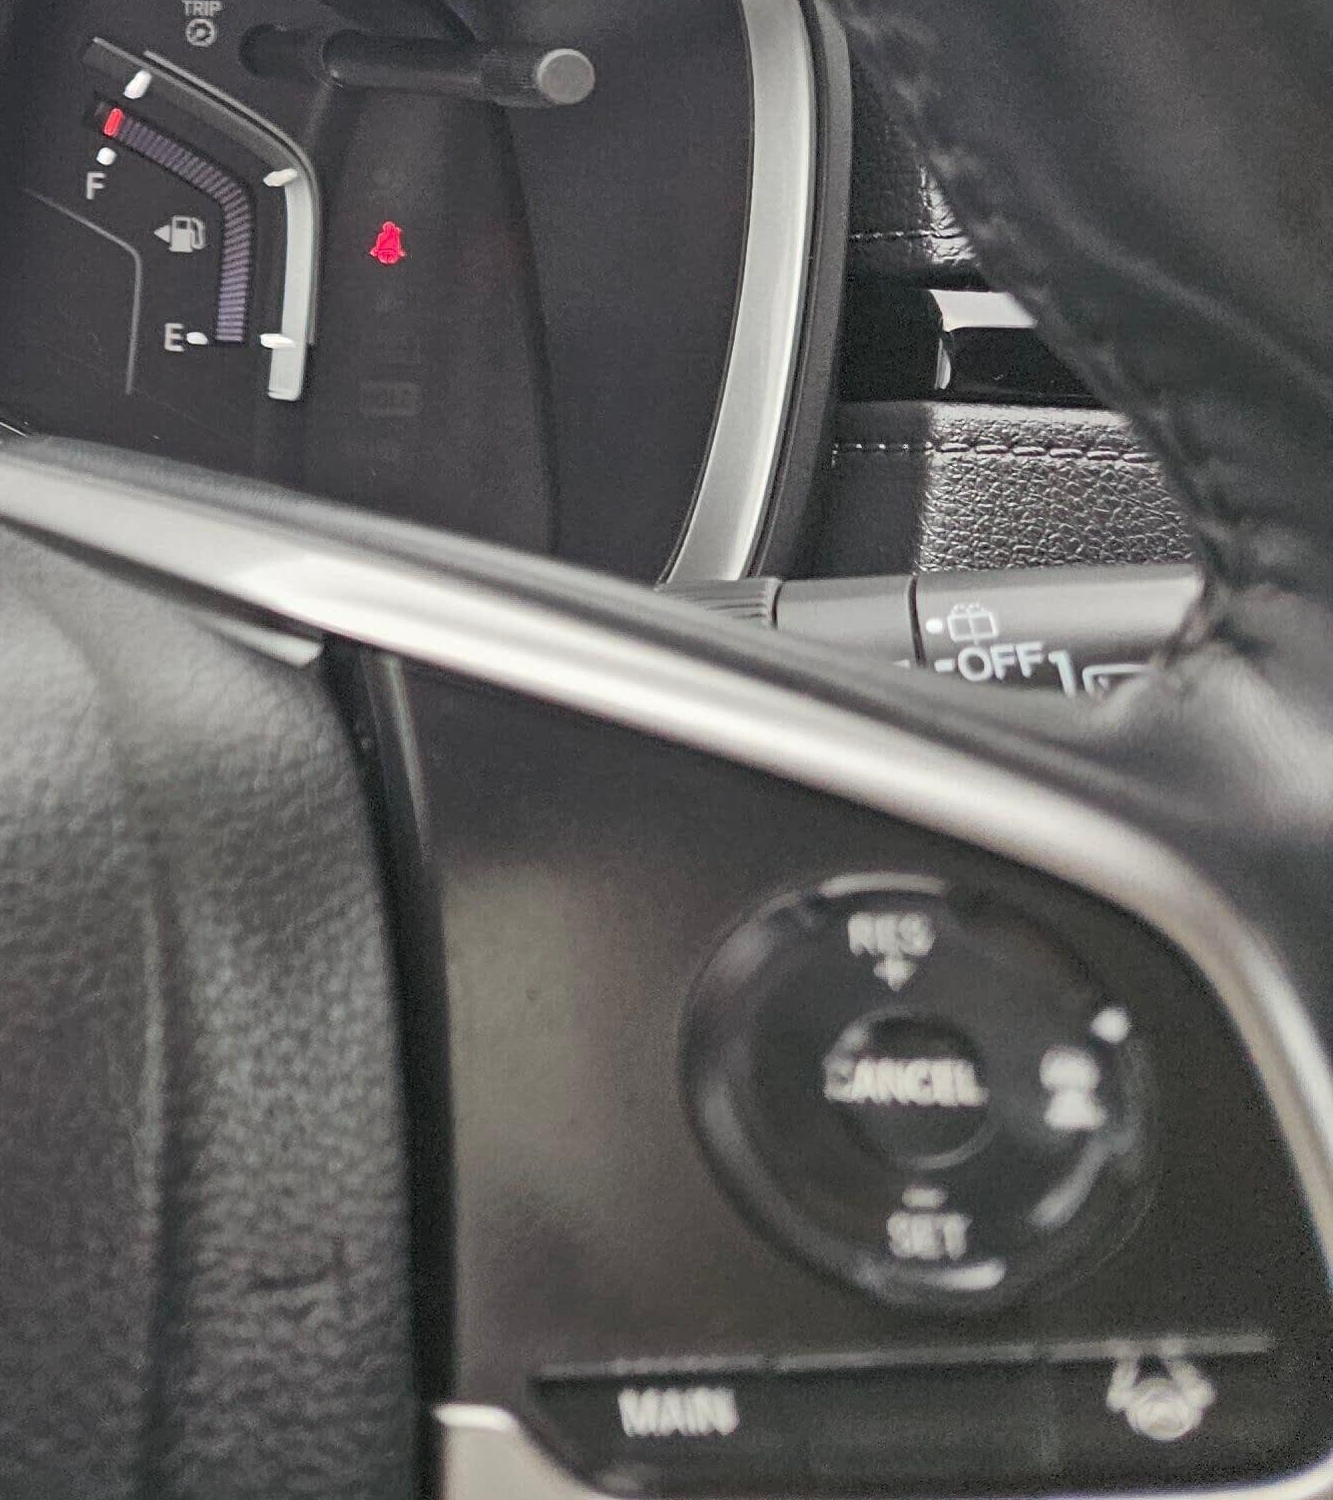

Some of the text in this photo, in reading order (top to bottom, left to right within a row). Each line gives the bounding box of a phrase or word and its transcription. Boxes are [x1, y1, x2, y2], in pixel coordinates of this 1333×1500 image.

[86, 172, 107, 199] F
[164, 323, 185, 352] E
[956, 641, 1045, 683] OFF
[848, 911, 934, 957] RES
[824, 1057, 989, 1107] CANCEL
[887, 1211, 972, 1260] SET
[618, 1388, 739, 1437] MAIN
